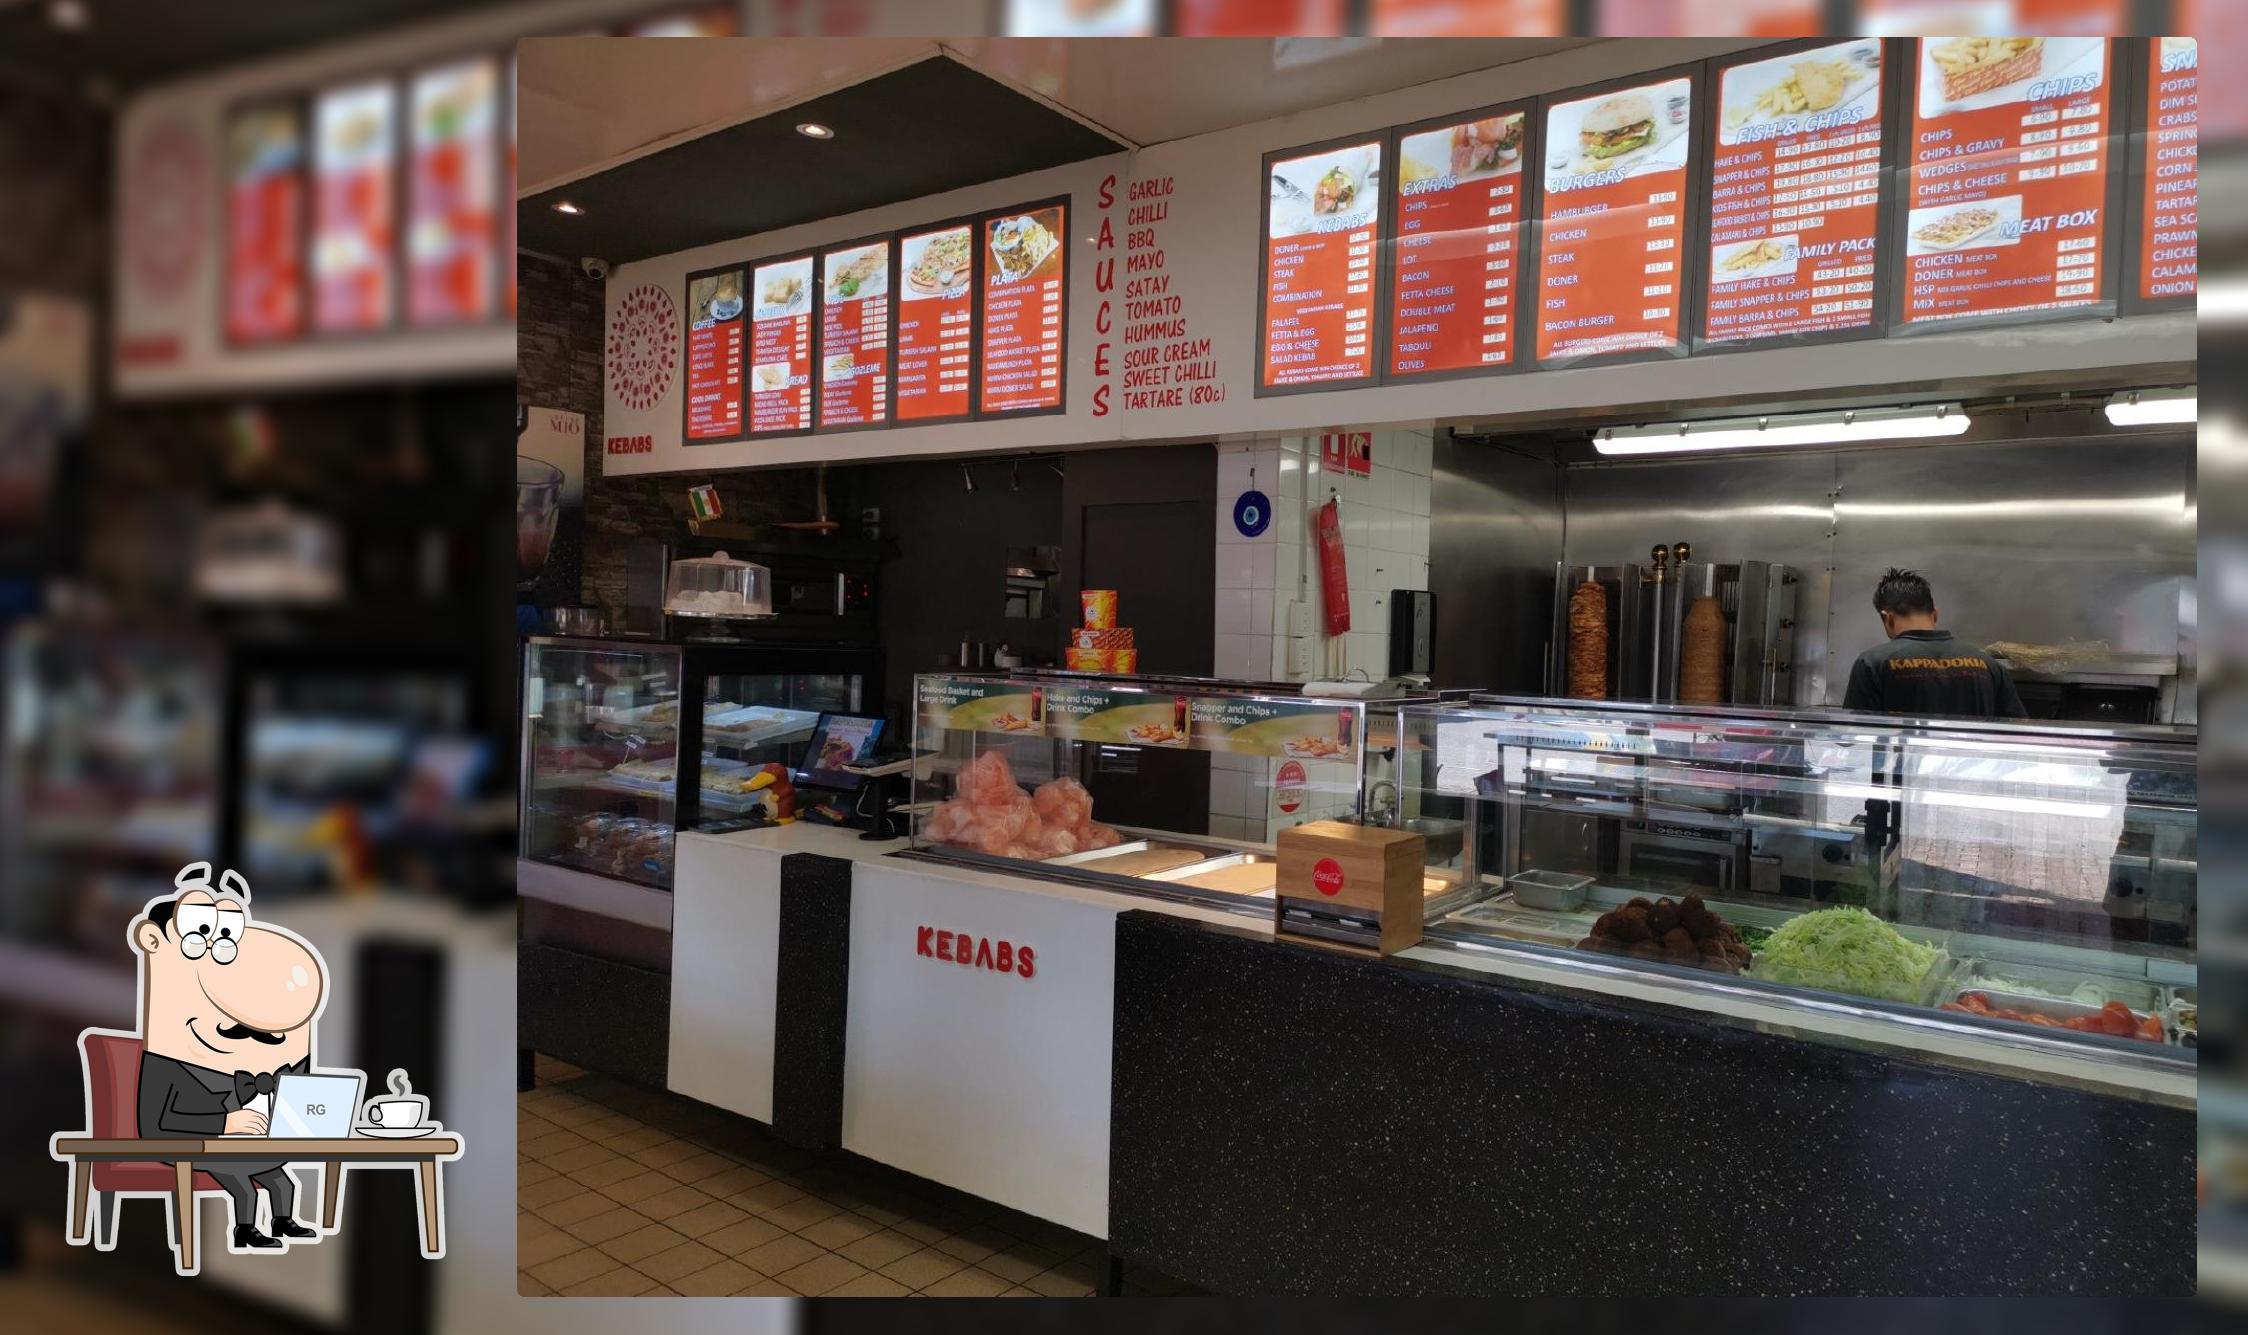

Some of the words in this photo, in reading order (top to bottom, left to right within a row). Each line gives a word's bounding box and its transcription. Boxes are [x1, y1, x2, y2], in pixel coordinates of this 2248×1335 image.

[2161, 49, 2197, 73] SN
[2027, 72, 2098, 102] CHIPS
[2160, 97, 2185, 110] DIM
[1736, 123, 1778, 145] FISH
[1783, 119, 1798, 136] &
[1805, 106, 1864, 131] CHIPS
[1920, 128, 1953, 143] CHIPS
[1919, 146, 1951, 161] CHIPS
[1954, 144, 1964, 156] &
[1966, 137, 2005, 154] GRAVY
[1741, 151, 1763, 163] CHIPS
[1713, 171, 1743, 185] SNAPPER
[1750, 166, 1770, 178] CHIPS
[1919, 162, 1967, 179] WEDGES
[2156, 162, 2192, 177] CORN
[1403, 175, 1457, 196] EXTRAS
[1549, 167, 1626, 194] BURGERS
[1744, 182, 1766, 194] CHIPS
[1918, 181, 1950, 196] CHIPS
[1952, 179, 1962, 190] &
[1965, 172, 2008, 189] CHEESE
[1129, 176, 1174, 201] GARLIC
[1405, 201, 1428, 212] CHIPS
[1751, 196, 1771, 207] CHIPS
[1128, 202, 1169, 226] CHILLI
[1551, 204, 1608, 220] HAMBURGER
[1405, 220, 1420, 230] EGG
[2000, 216, 2053, 238] MEAT
[2056, 209, 2098, 229] BOX
[2154, 215, 2177, 228] SEA
[2181, 213, 2197, 224] SC
[1549, 229, 1587, 242] CHICKEN
[1748, 226, 1766, 237] CHIPS
[1127, 229, 1154, 250] BBQ
[1404, 236, 1432, 247] CHEESE
[1784, 243, 1836, 263] FAMILY
[1839, 237, 1876, 254] PACK
[1127, 250, 1164, 274] MAYO
[1274, 255, 1304, 267] CHICKEN
[1548, 253, 1575, 264] STEAK
[1915, 253, 1963, 268] CHICKEN
[1273, 269, 1294, 279] STEAK
[1402, 271, 1430, 282] BACON
[1547, 275, 1578, 287] DONER
[1915, 269, 1953, 282] DONER
[1126, 275, 1170, 299] SATAY
[1711, 283, 1739, 294] FAMILY
[1741, 278, 1762, 290] HAKE
[1772, 275, 1796, 286] CHIPS
[1914, 283, 1935, 296] HSP
[2151, 281, 2194, 295] ONION
[1093, 175, 1116, 417] SAUCES
[1273, 290, 1323, 303] COMBINATION
[1401, 290, 1424, 300] FETTA
[1425, 286, 1455, 297] CHEESE
[1711, 299, 1738, 310] FAMILY
[1740, 293, 1775, 307] SNAPPER
[1785, 289, 1810, 300] CHIPS
[1125, 296, 1181, 321] TOMATO
[1401, 306, 1431, 317] DOUBLE
[1434, 303, 1456, 313] MEAT
[1546, 299, 1565, 309] FISH
[1913, 299, 1935, 310] MIX
[1545, 320, 1576, 331] BACON
[1578, 315, 1616, 327] BURGER
[1711, 315, 1737, 326] FAMILY
[1775, 307, 1799, 318] CHIPS
[1125, 318, 1186, 345] HUMMUS
[1400, 323, 1439, 335] JALAPENO
[1124, 347, 1159, 370] SOUR
[1164, 338, 1211, 363] CREAM
[1399, 342, 1432, 353] TABOULI
[1398, 360, 1424, 370] OLIVES
[1123, 369, 1170, 389] SWEET
[1175, 361, 1216, 383] CHILLI
[1123, 387, 1182, 411] TARTARE
[1189, 383, 1225, 405] (80c)
[608, 434, 652, 455] KEBABS
[1889, 656, 1988, 670] KAPPADOKIA
[919, 685, 948, 696] Seafood
[948, 686, 970, 697] Basket
[971, 687, 984, 697] and
[939, 695, 957, 705] Drink
[1066, 694, 1081, 704] and
[1082, 695, 1104, 706] Chips
[1104, 697, 1110, 705] +
[1047, 703, 1066, 713] Drink
[1067, 703, 1095, 714] Combo
[1191, 702, 1226, 713] Snapper
[1227, 704, 1244, 714] and
[1246, 705, 1270, 717] Chips
[1191, 712, 1214, 722] Drink
[1215, 714, 1247, 725] Combo
[917, 926, 1035, 978] KEBABS
